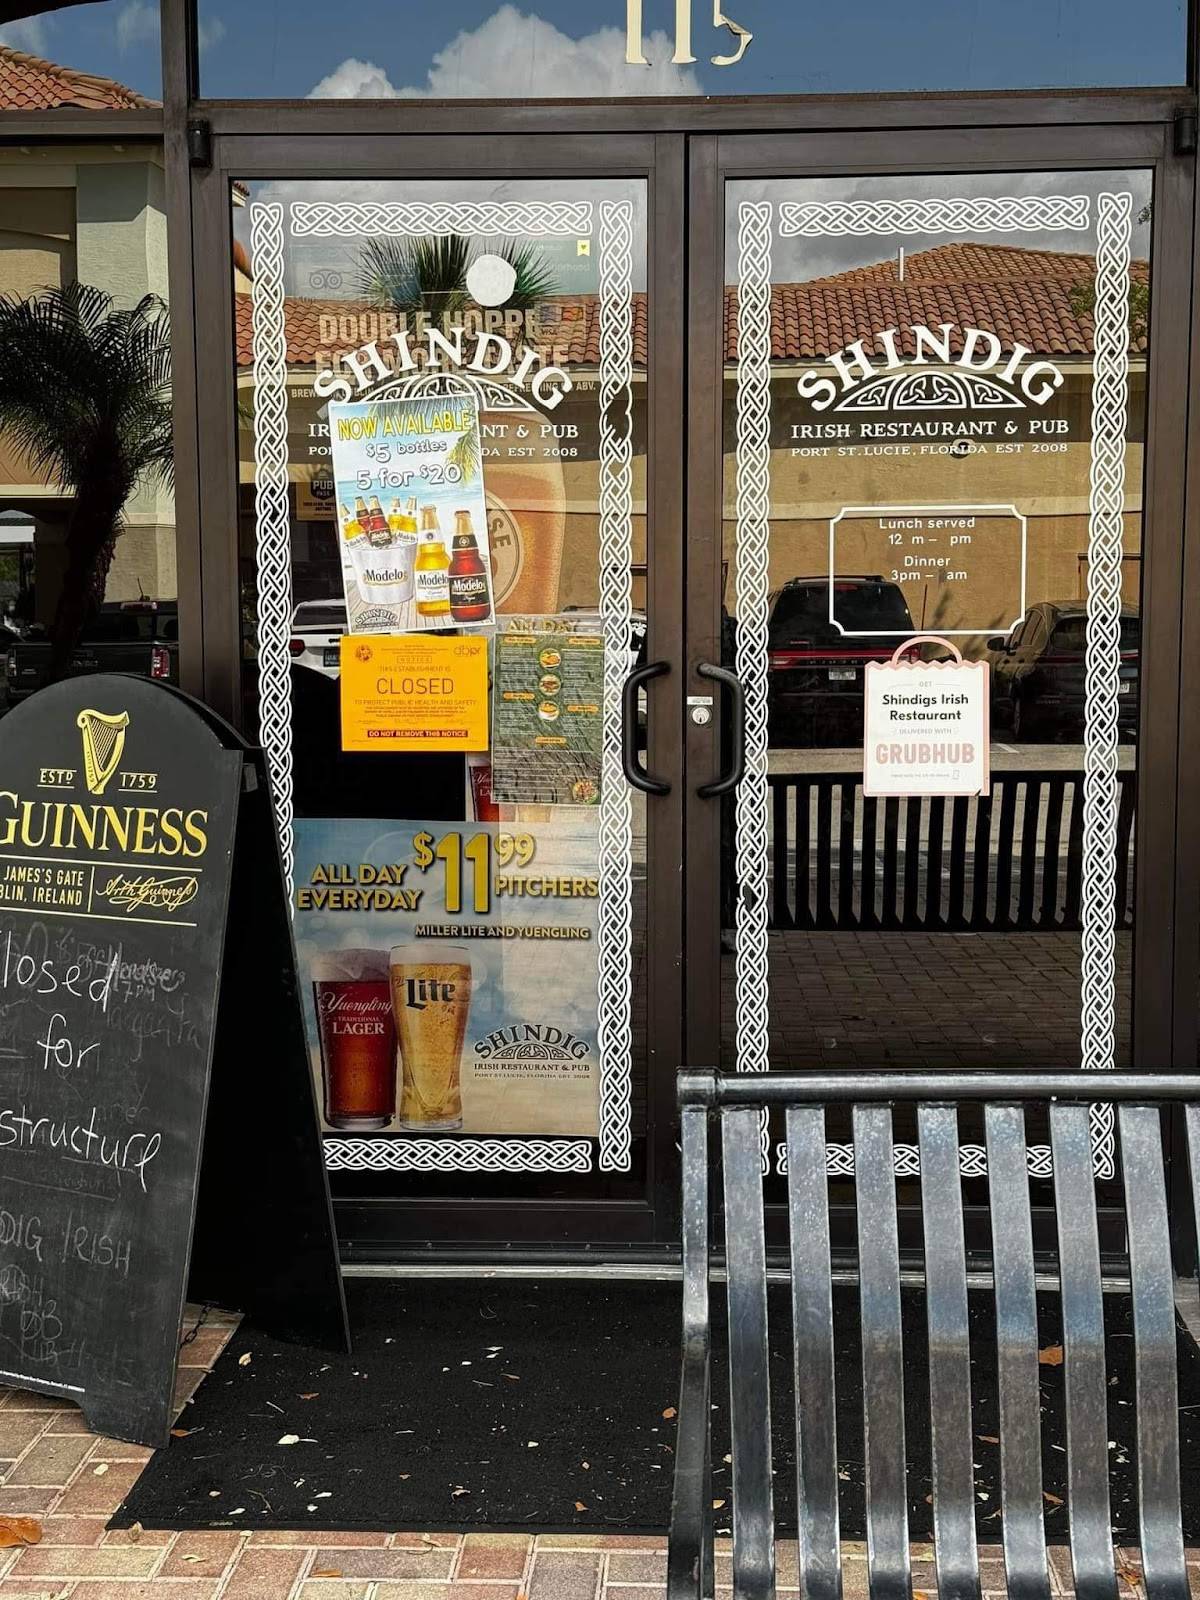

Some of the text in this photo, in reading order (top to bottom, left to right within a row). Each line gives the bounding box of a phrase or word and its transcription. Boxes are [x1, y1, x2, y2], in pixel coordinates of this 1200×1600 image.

[314, 327, 573, 411] SHINDIG
[797, 323, 1064, 411] SHINDIG
[337, 409, 472, 441] NOW AVAILABLE
[516, 424, 530, 438] &
[540, 424, 579, 438] PUB
[791, 420, 1070, 439] IRISH RESTAURANT & PUB
[366, 438, 448, 463] $5 bottles
[507, 447, 536, 457] EST
[543, 447, 578, 457] 2008
[791, 448, 830, 457] PORT
[920, 444, 988, 456] FLORIDA
[995, 443, 1024, 454] EST
[1031, 443, 1068, 454] 2008
[356, 463, 463, 490] 5 for $20
[879, 516, 976, 529] Lunch served
[888, 533, 903, 545] 12
[950, 535, 972, 547] pm
[904, 555, 951, 567] Dinner
[365, 568, 404, 583] Modelo
[418, 573, 449, 586] Modelo
[891, 569, 921, 583] 3pm
[946, 571, 968, 580] am
[453, 578, 483, 592] Modelo
[377, 677, 454, 695] CLOSED
[881, 693, 969, 707] Shindigs Irish
[890, 710, 962, 721] Restaurant
[368, 730, 467, 738] DO NOT REMOVE THIS NOTICE
[875, 743, 975, 765] GRUBHUB
[121, 774, 157, 789] 1759
[0, 791, 208, 858] GUINNESS
[4, 866, 85, 887] JAMES'S GATE
[311, 864, 407, 885] ALL DAY
[494, 877, 598, 897] PITCHERS
[33, 887, 83, 906] IRELAND
[297, 889, 422, 910] EVERYDAY
[415, 925, 590, 939] MILLER LITE AND YUENGLING
[0, 930, 120, 1012] losed
[320, 991, 393, 1015] Yuengling
[405, 978, 457, 1011] Lite
[333, 1022, 385, 1035] LAGER
[37, 1013, 101, 1070] for
[474, 1024, 590, 1060] SHINDIG
[474, 1063, 590, 1072] IRISH RESTAURANT & PUB
